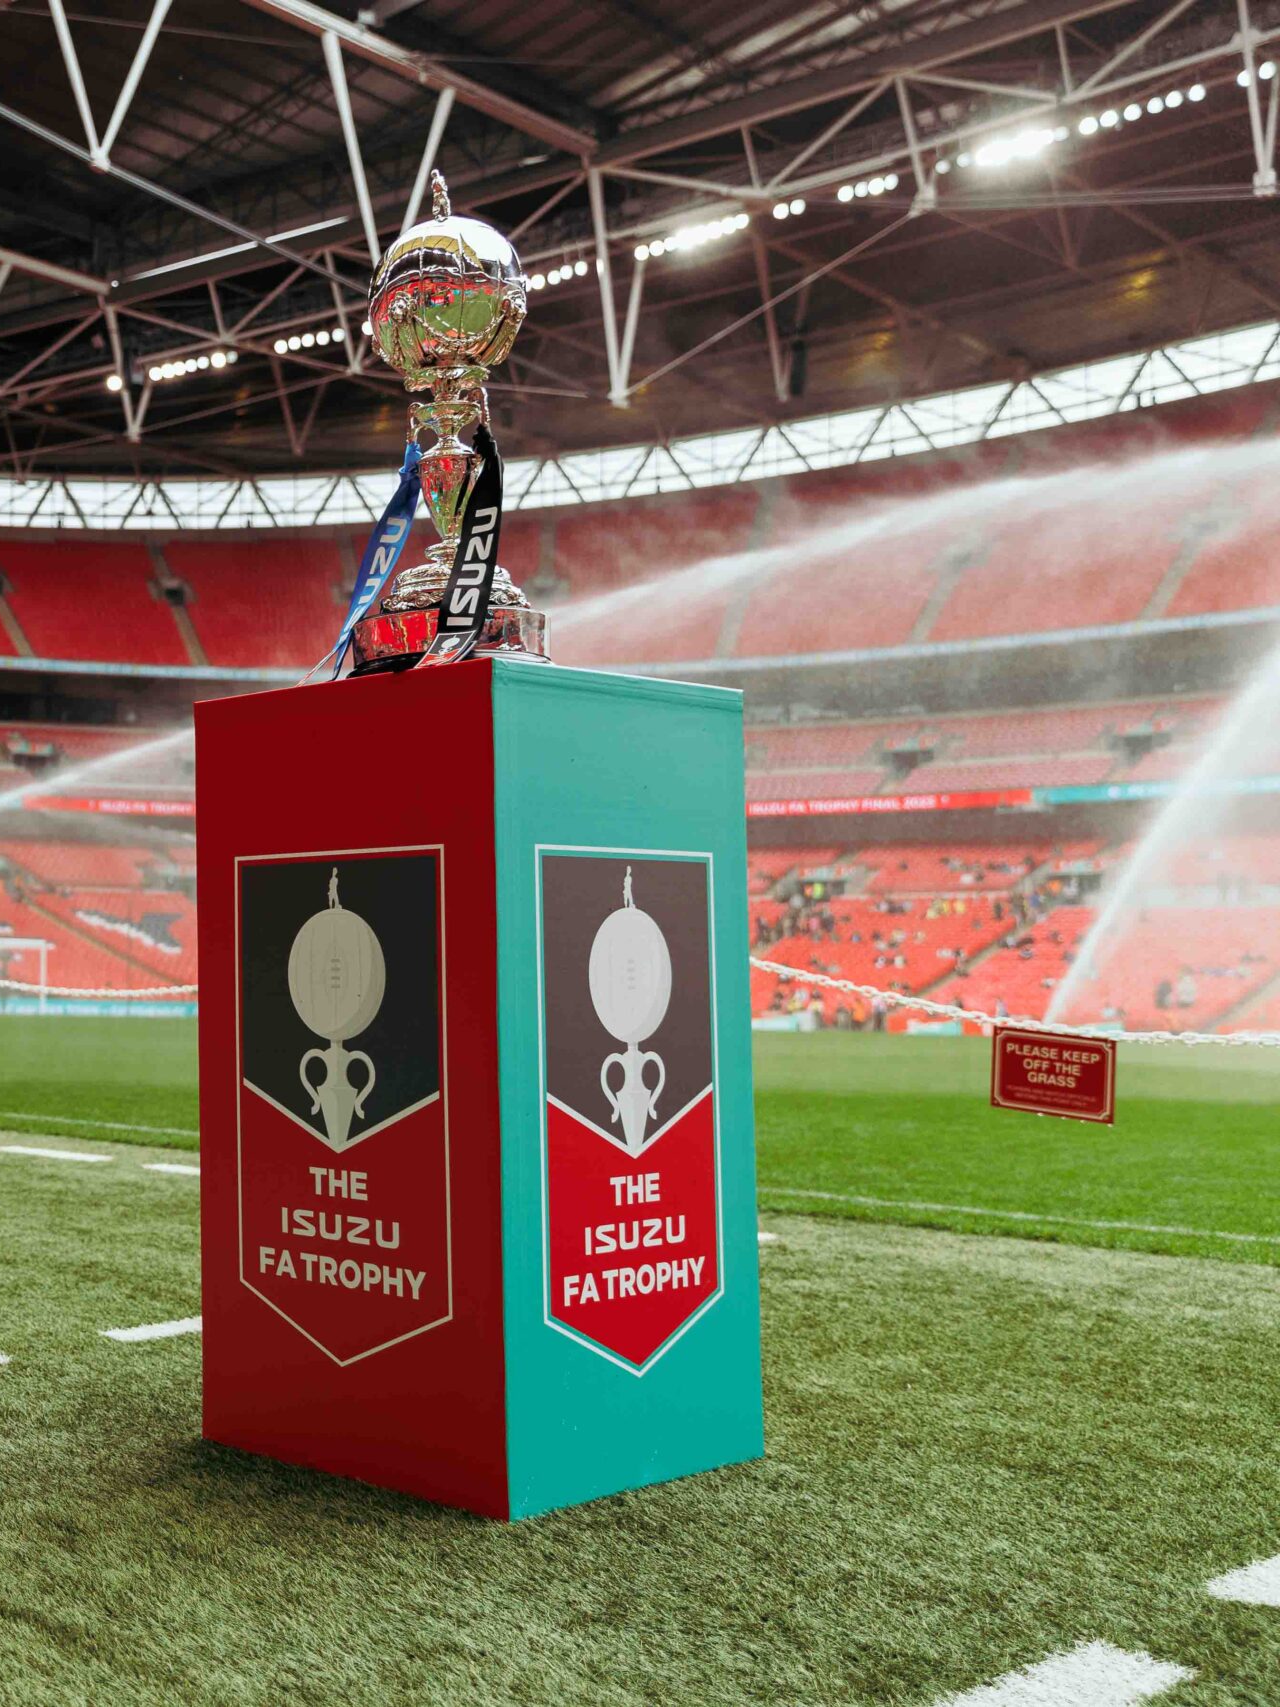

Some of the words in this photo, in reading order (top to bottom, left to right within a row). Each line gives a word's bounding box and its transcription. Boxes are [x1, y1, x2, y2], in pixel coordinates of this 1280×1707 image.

[446, 506, 499, 627] ISUZU
[1006, 1043, 1058, 1060] PLEASE
[1062, 1050, 1100, 1064] KEEP
[1023, 1058, 1049, 1071] OFF
[1053, 1062, 1081, 1076] THE
[1027, 1071, 1076, 1088] GRASS
[309, 1166, 368, 1201] THE
[610, 1172, 660, 1206] THE
[281, 1206, 400, 1249] ISUZU
[584, 1214, 685, 1256] ISUZU
[259, 1246, 297, 1279] FA
[300, 1252, 427, 1300] TROPHY
[563, 1272, 600, 1307] FA
[602, 1256, 706, 1300] TROPHY
